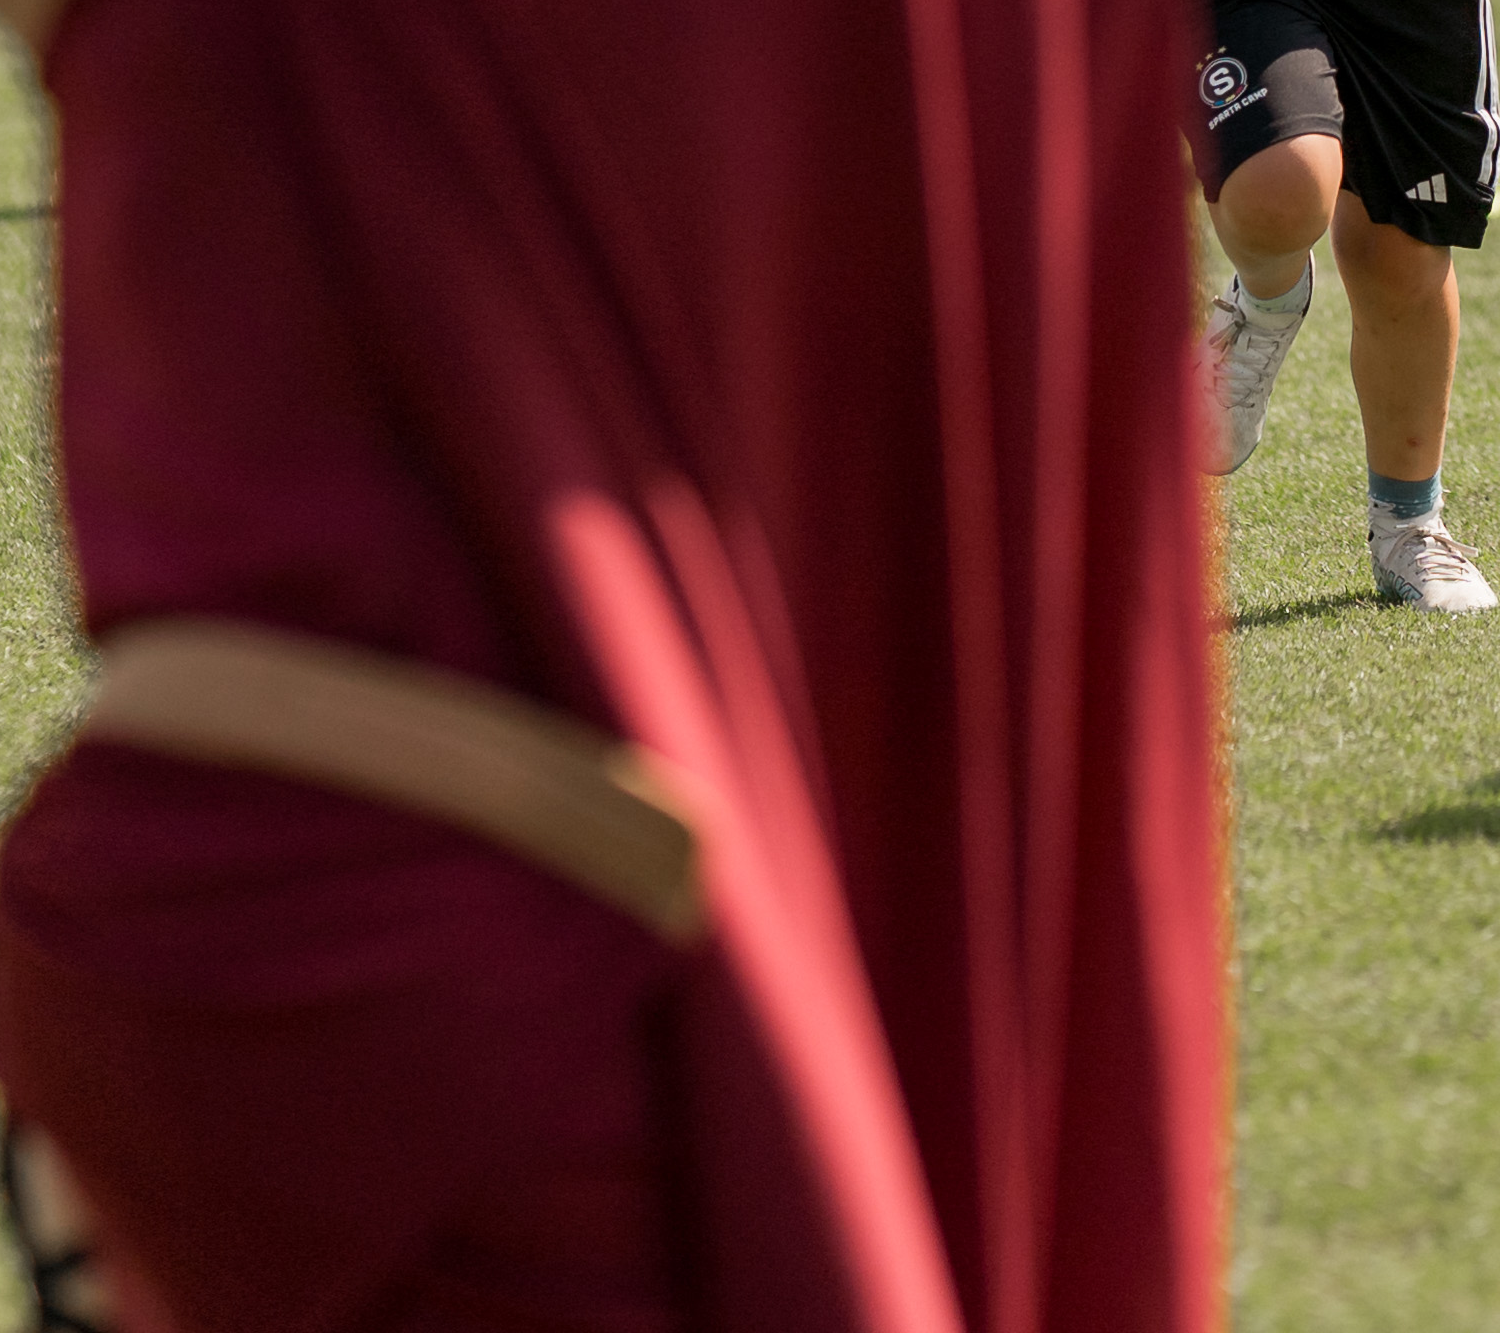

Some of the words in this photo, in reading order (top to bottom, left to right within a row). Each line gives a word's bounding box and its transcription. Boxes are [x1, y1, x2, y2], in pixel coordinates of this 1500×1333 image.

[1209, 67, 1235, 96] S
[1208, 102, 1242, 130] SPARTA
[1241, 88, 1268, 106] CAMP
